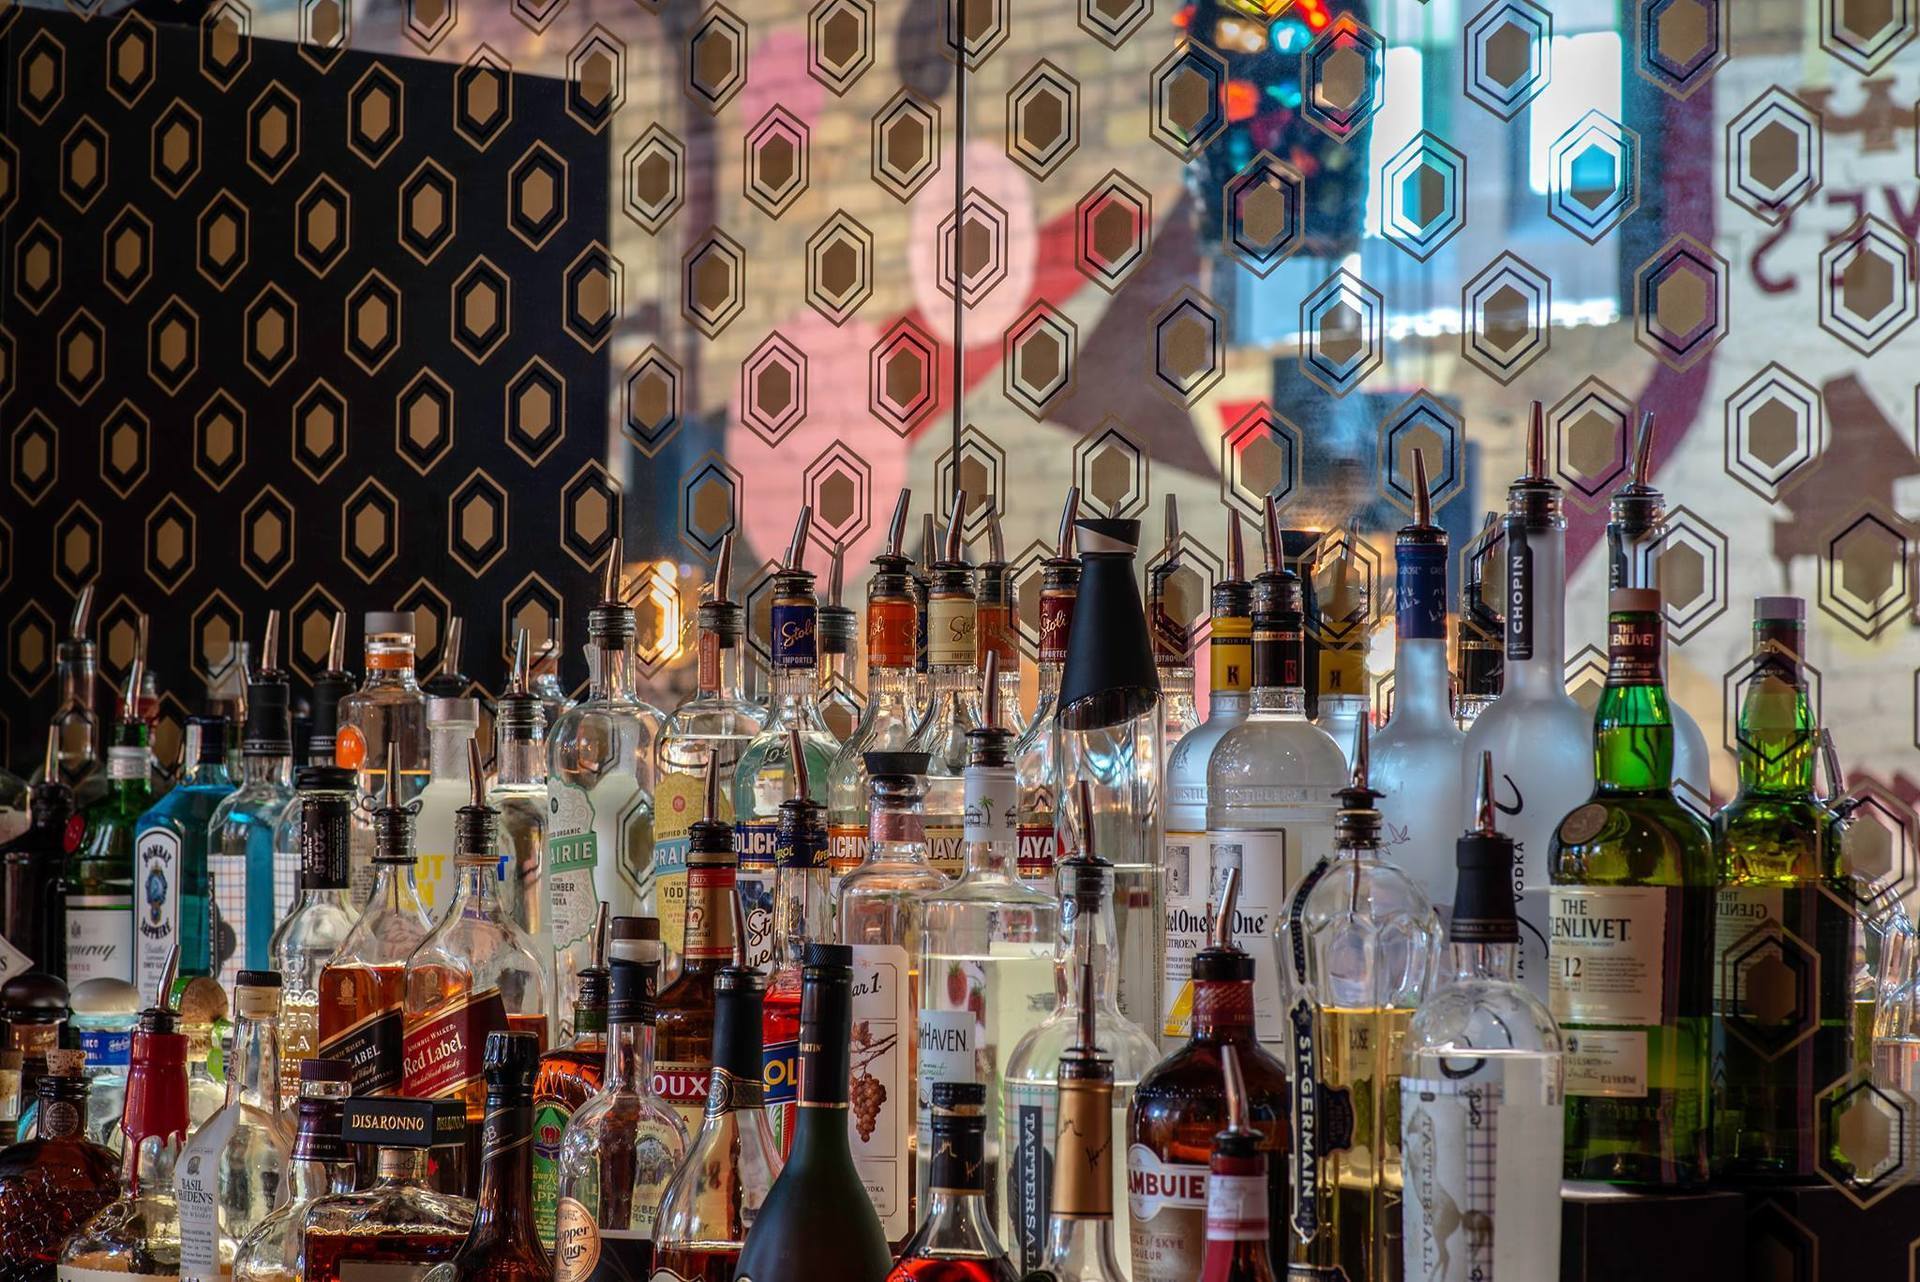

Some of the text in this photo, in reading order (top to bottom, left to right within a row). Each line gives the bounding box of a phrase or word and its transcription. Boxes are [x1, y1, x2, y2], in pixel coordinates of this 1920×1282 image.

[1512, 555, 1523, 634] CHOPIN
[781, 620, 815, 647] Stoli
[1041, 610, 1068, 640] Stoli
[1617, 624, 1635, 634] THE
[1514, 841, 1524, 903] VODKA
[1561, 899, 1588, 915] THE
[1563, 956, 1582, 978] 12
[403, 1050, 427, 1078] Red
[351, 1113, 425, 1132] DISARONNO
[1423, 1116, 1433, 1275] TATTERSALL
